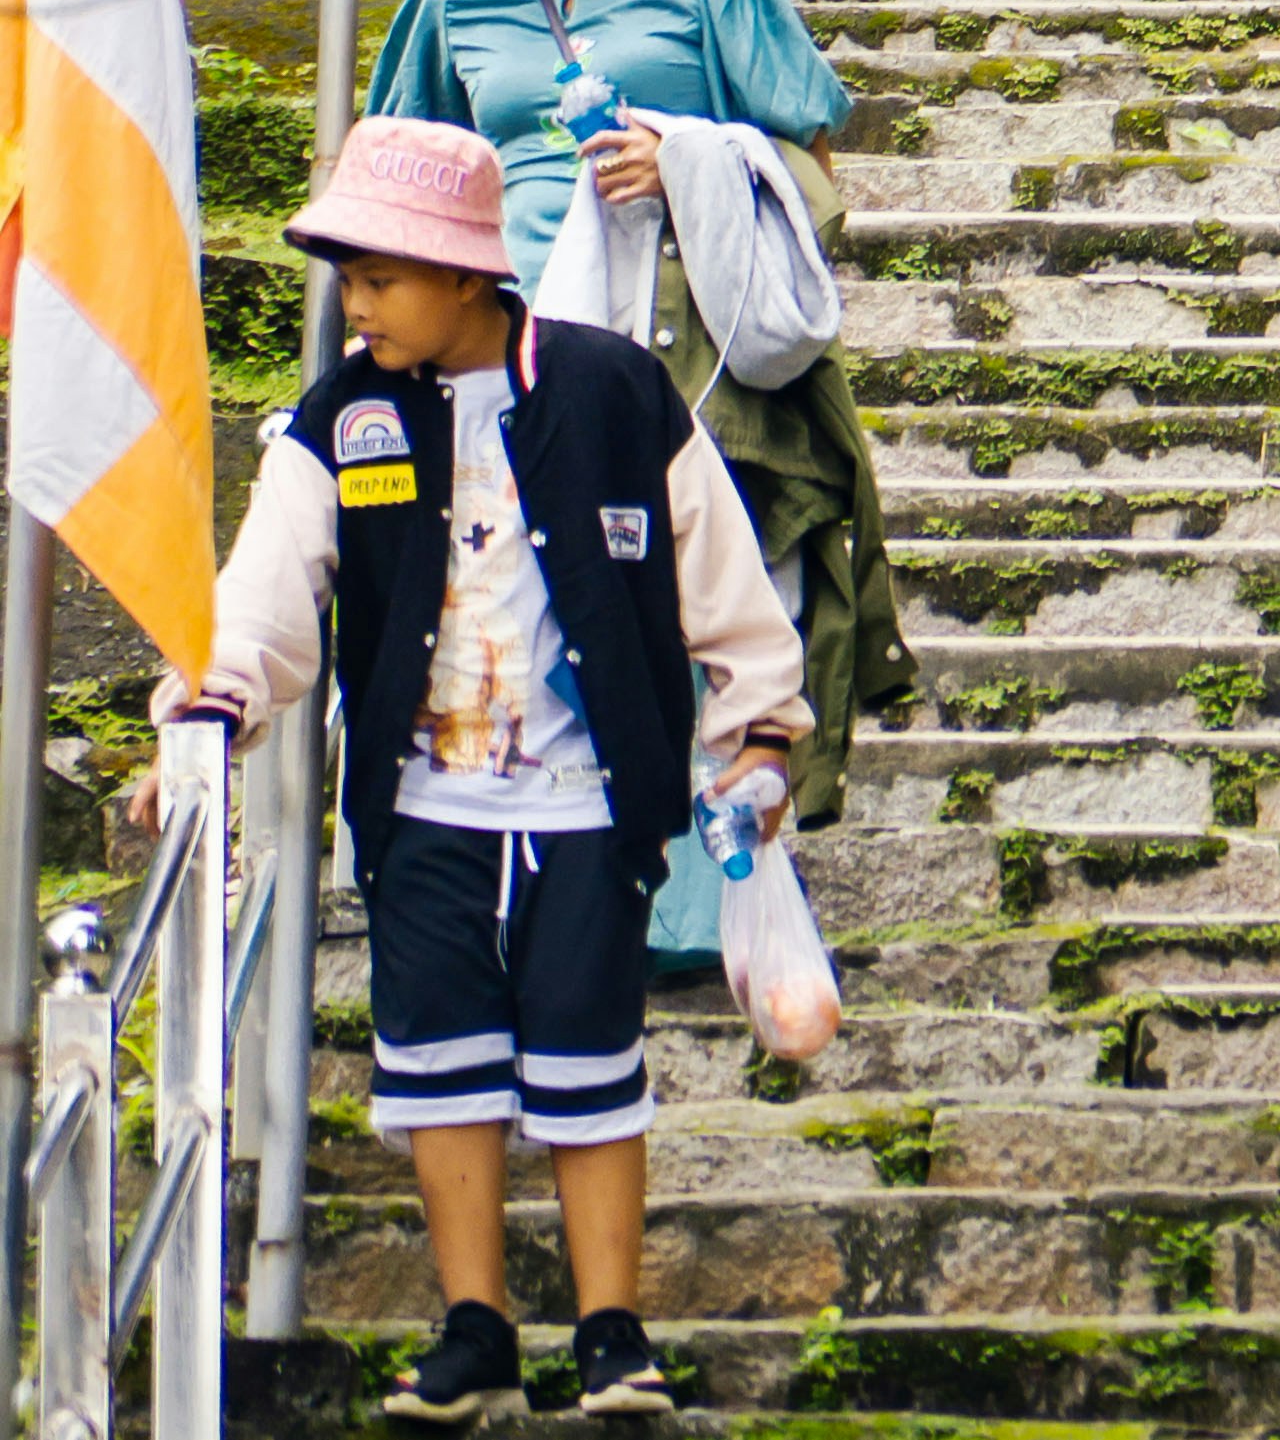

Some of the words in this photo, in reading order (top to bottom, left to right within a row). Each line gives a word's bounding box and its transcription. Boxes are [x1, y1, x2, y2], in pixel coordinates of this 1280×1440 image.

[370, 149, 469, 198] GUCCI
[349, 478, 380, 495] DEEP
[383, 476, 410, 493] END
